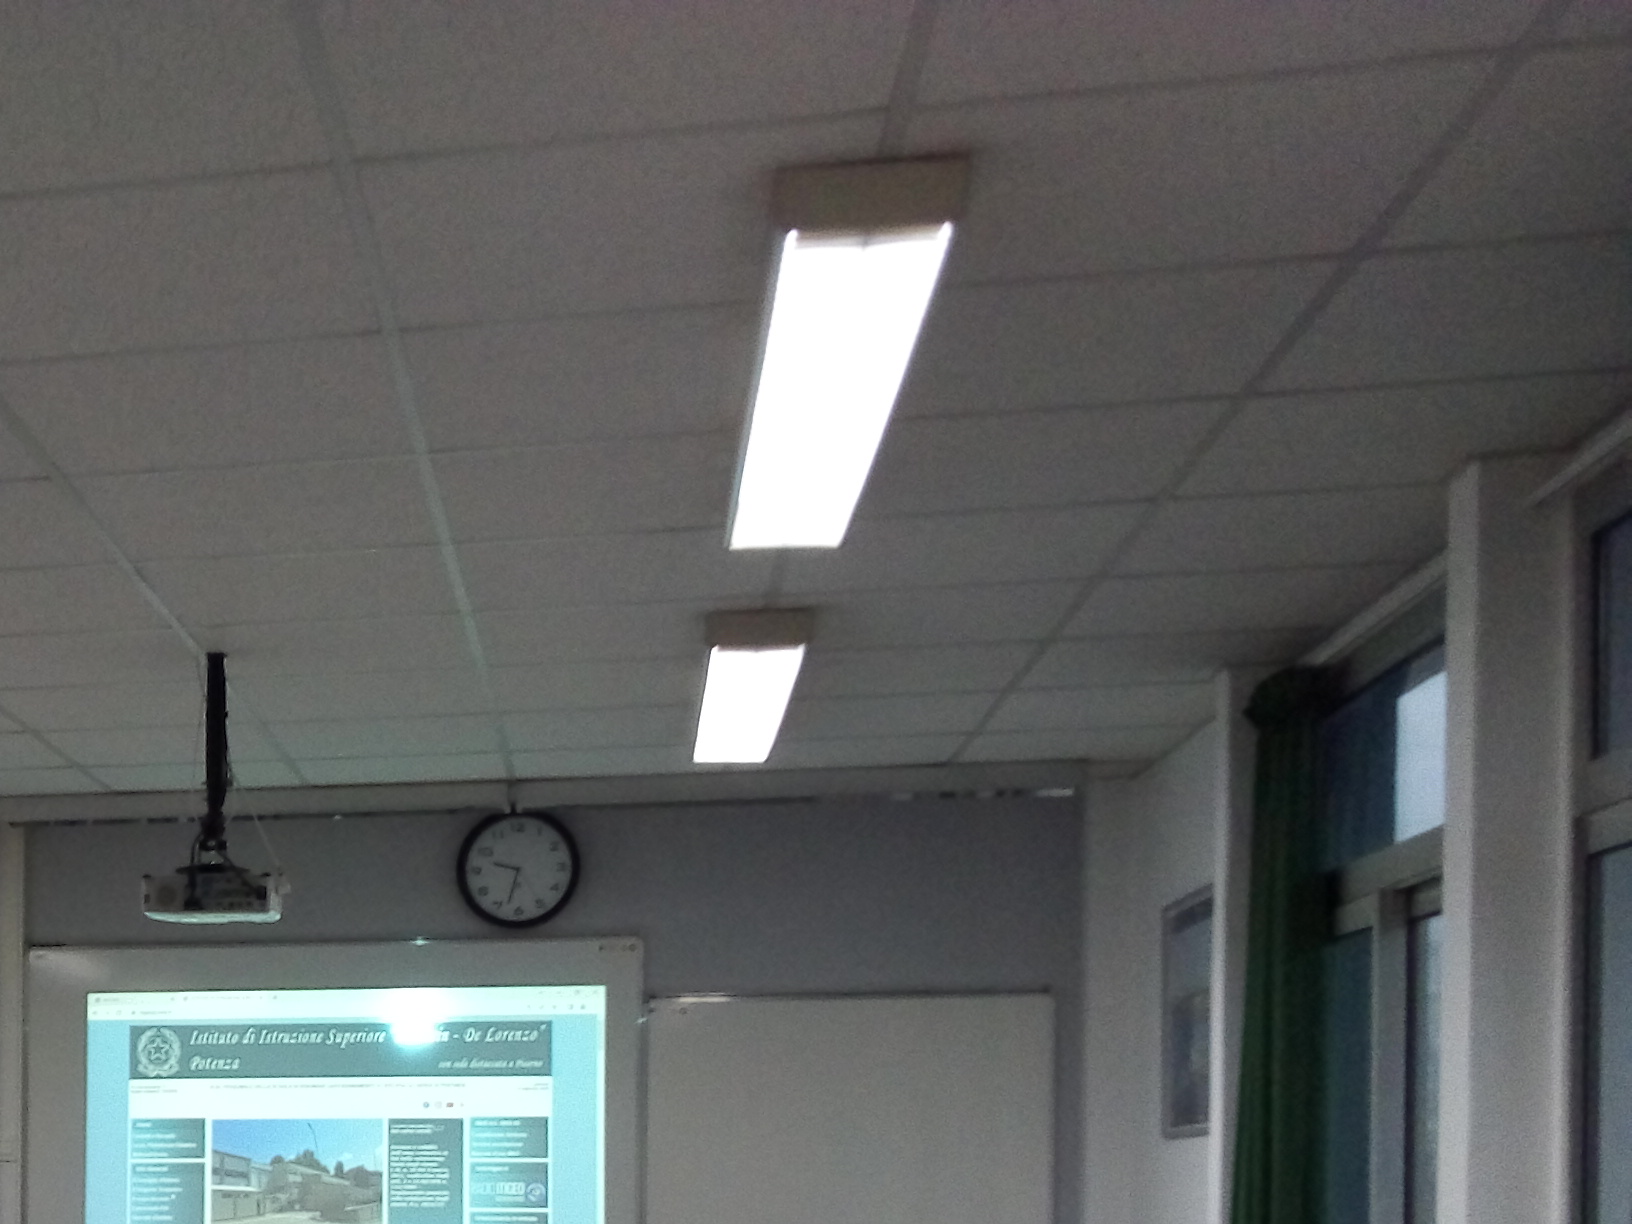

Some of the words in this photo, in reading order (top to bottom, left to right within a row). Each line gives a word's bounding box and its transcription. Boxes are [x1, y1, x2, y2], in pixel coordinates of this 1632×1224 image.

[189, 1028, 238, 1046] Istituto
[242, 1027, 255, 1045] di
[258, 1028, 324, 1045] Istruzione
[325, 1027, 386, 1049] Superiore
[463, 1027, 481, 1043] De
[189, 1056, 241, 1071] Potenza
